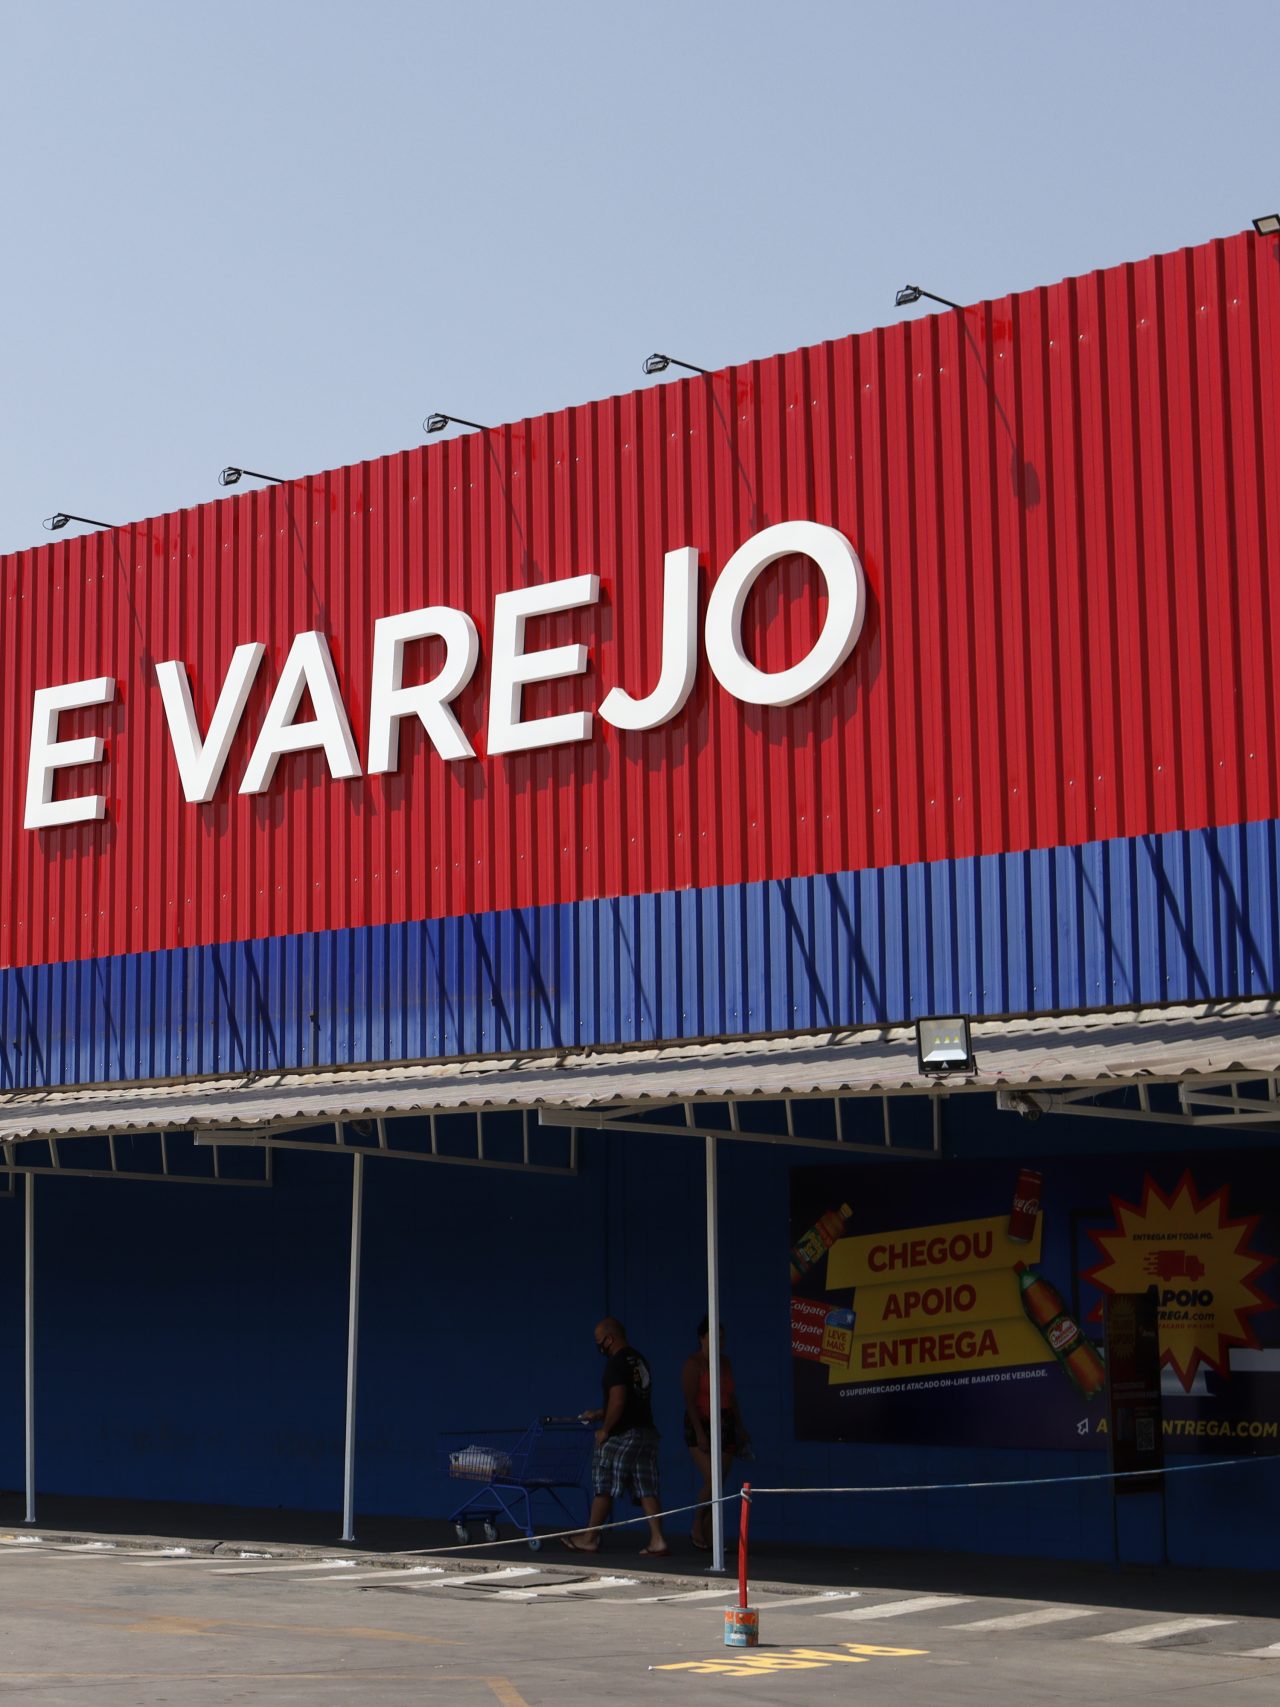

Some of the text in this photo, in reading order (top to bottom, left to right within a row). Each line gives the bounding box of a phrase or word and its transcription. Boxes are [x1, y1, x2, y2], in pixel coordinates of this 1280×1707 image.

[24, 676, 115, 830] E
[155, 520, 866, 803] VAREJO
[867, 1231, 993, 1273] CHEGOU
[882, 1284, 976, 1320] APOIO
[1156, 1311, 1214, 1320] TREGA.com
[791, 1320, 823, 1335] olgate
[828, 1330, 847, 1342] LEVE
[826, 1340, 845, 1353] MAIS
[861, 1328, 999, 1370] ENTREGA
[846, 1384, 900, 1397] SUPERMERCADO
[907, 1380, 939, 1391] ATACADO
[940, 1377, 970, 1387] ON-LINE
[971, 1374, 1000, 1384] BARATO
[1001, 1373, 1011, 1381] DE
[1012, 1369, 1048, 1380] VERDADE.
[1096, 1418, 1277, 1437] ANTREGA.COM
[652, 1642, 931, 1677] PARE
